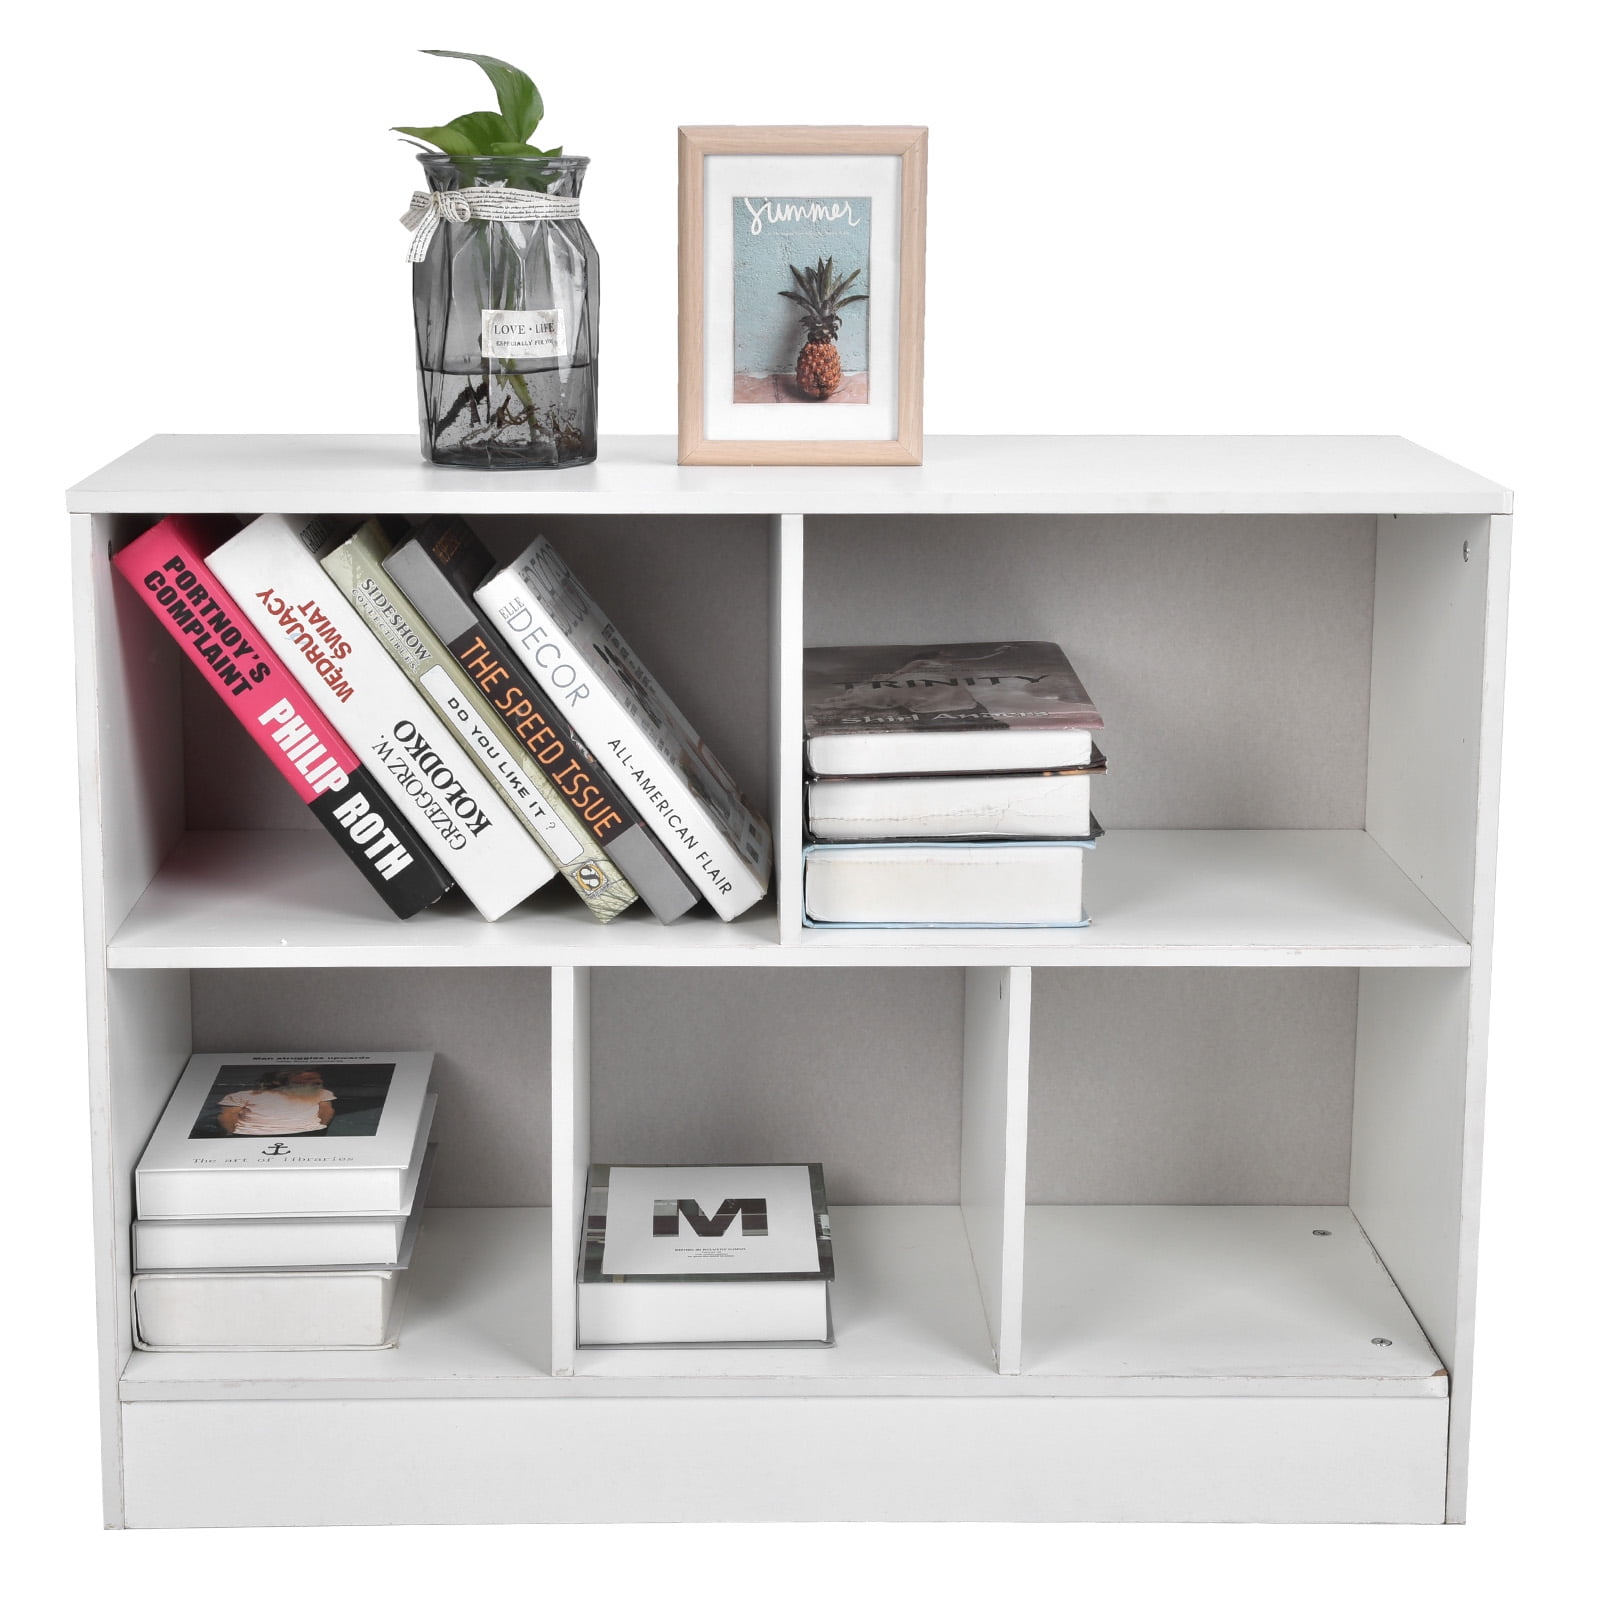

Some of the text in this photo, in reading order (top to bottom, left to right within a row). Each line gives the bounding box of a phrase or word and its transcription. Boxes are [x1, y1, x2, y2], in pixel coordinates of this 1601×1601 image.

[494, 322, 555, 335] LOVE LIFE
[144, 570, 253, 696] COMPLAINT
[163, 555, 271, 683] PORTNOY'S
[256, 588, 354, 703] WĘDRUJĄCY
[297, 600, 352, 659] ŚWIAT
[362, 578, 431, 661] SIDESHOW
[498, 597, 525, 620] ELLE
[507, 607, 590, 707] DECOR
[460, 636, 509, 693] THE
[494, 687, 564, 764] SPEED
[552, 758, 622, 838] ISSUE
[832, 673, 1050, 691] TRINITY
[257, 697, 414, 881] PHILIP ROTH
[371, 734, 467, 850] GRZEGORZ W.
[393, 720, 493, 838] KOŁODKO
[448, 697, 469, 721] DO
[471, 725, 500, 758] YOU
[498, 761, 530, 798] LIKE
[529, 801, 546, 818] IT
[608, 739, 699, 850] ALL-AMERICAN
[696, 852, 732, 895] FLAIR
[652, 1198, 768, 1237] M
